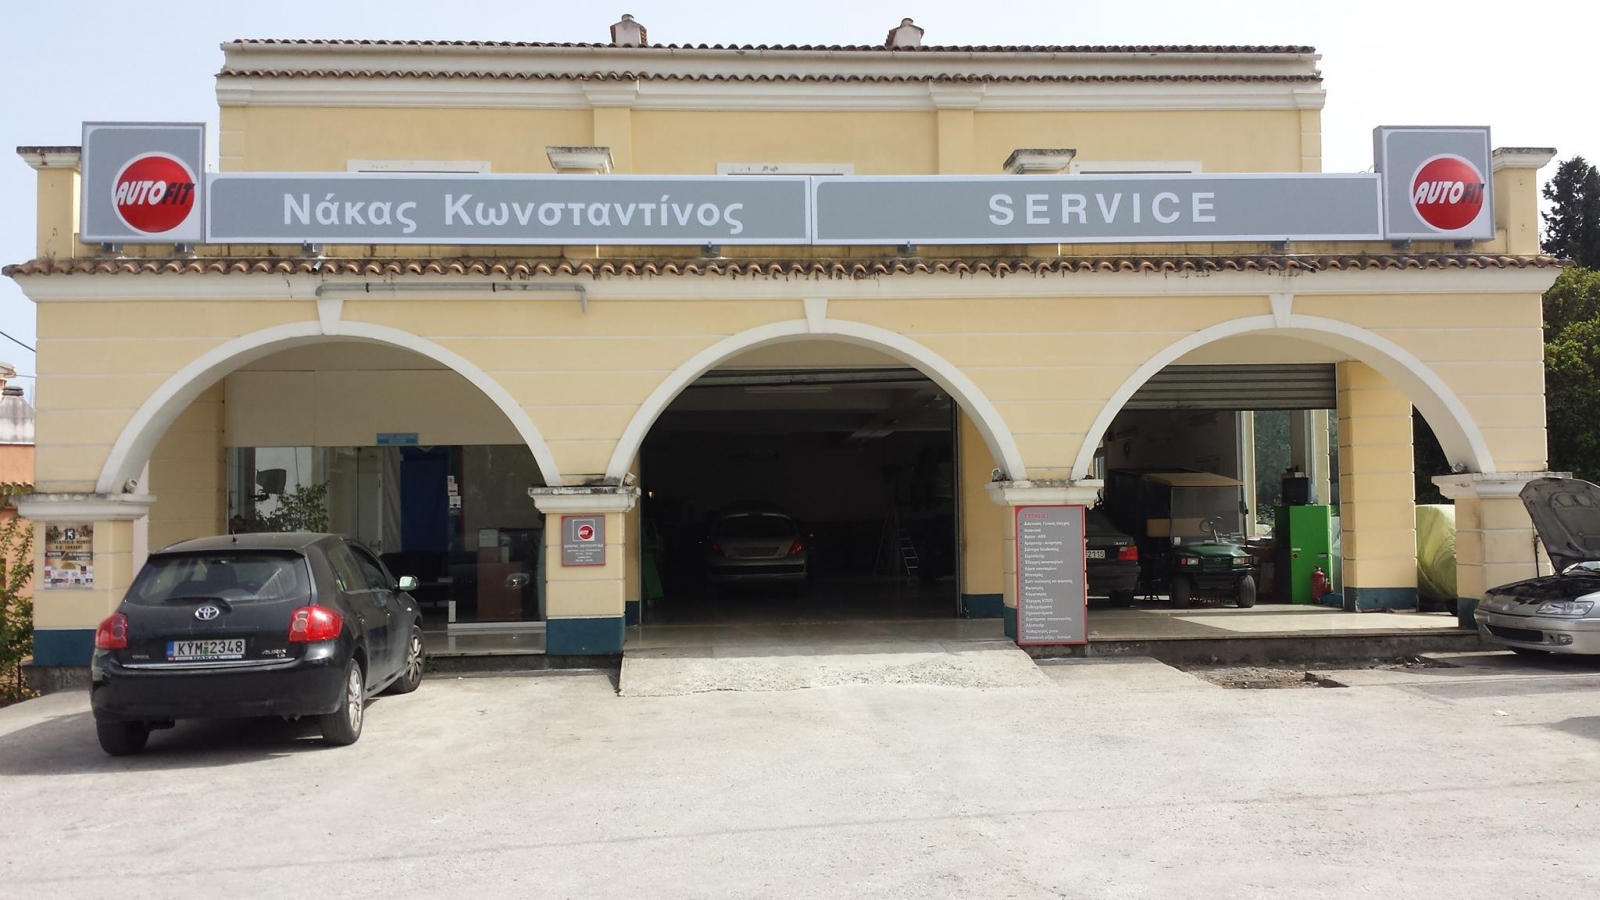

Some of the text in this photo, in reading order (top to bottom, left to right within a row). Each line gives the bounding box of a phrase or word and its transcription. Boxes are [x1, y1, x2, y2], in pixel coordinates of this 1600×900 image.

[116, 180, 195, 206] AUTOFIT
[1414, 181, 1485, 204] AUTOFIT
[284, 193, 744, 234] Νάκας Κωνσταντίνος
[988, 192, 1216, 226] SERVICE
[64, 528, 76, 540] 13
